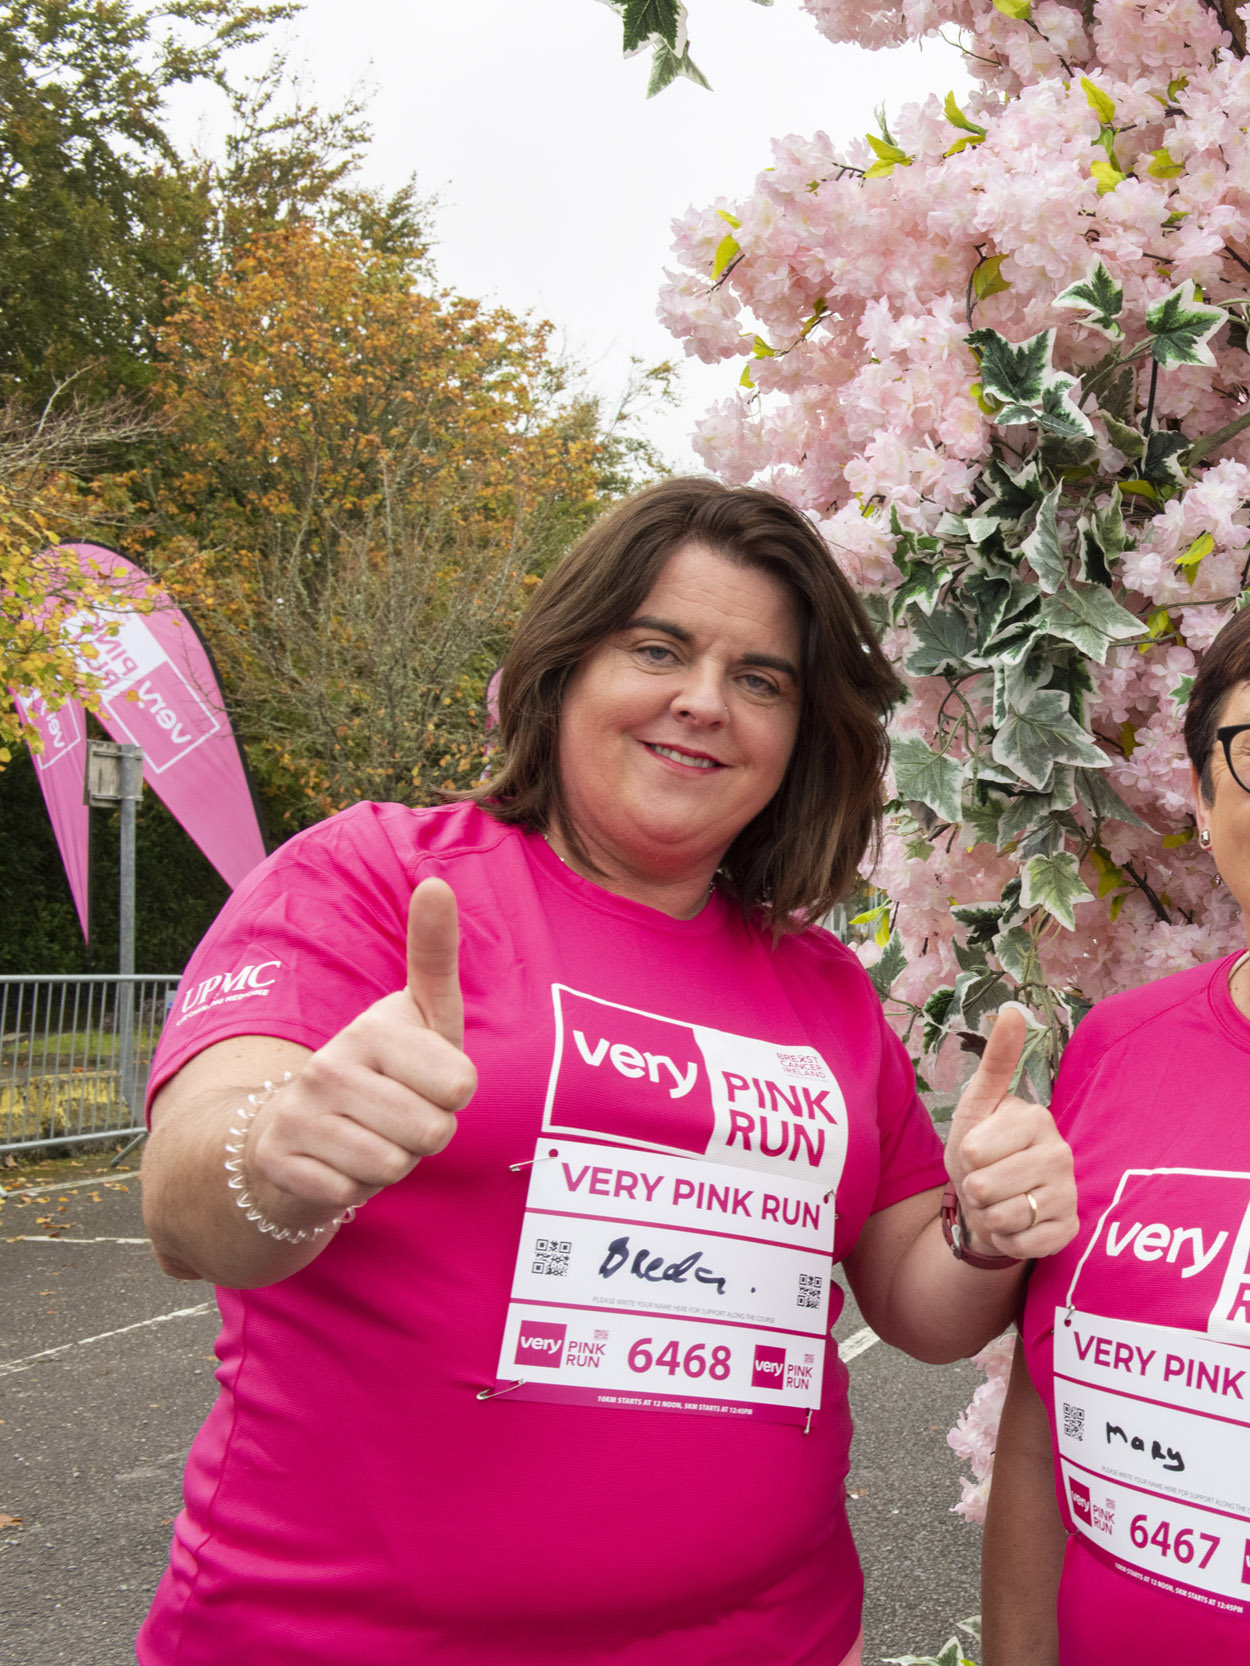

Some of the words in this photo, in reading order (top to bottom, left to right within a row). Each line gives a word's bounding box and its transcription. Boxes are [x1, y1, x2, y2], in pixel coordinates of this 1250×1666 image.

[182, 960, 282, 1013] UPMC
[572, 1029, 698, 1098] very
[783, 1067, 826, 1078] IRELAND
[721, 1071, 838, 1125] PINK
[725, 1108, 825, 1168] RUN
[561, 1162, 665, 1202] VERY
[672, 1178, 754, 1217] PINK
[761, 1193, 821, 1230] RUN
[1105, 1221, 1229, 1279] very
[592, 1296, 615, 1304] PLEASE
[616, 1299, 635, 1307] WRITE
[654, 1303, 672, 1311] NAME
[689, 1306, 700, 1314] FOR
[702, 1307, 726, 1317] SUPPORT
[727, 1311, 745, 1320] ALONG
[746, 1313, 756, 1321] THE
[756, 1315, 776, 1324] COURSE
[520, 1336, 562, 1354] very
[568, 1340, 606, 1355] PINK
[627, 1337, 732, 1380] 6468
[565, 1354, 600, 1368] RUN
[755, 1359, 784, 1377] very
[787, 1364, 813, 1378] PINK
[1073, 1331, 1157, 1376] VERY
[1163, 1354, 1247, 1400] PINK
[786, 1376, 809, 1390] RUN
[617, 1397, 642, 1405] STARTS
[653, 1399, 660, 1407] 12
[698, 1404, 720, 1412] STARTS
[1071, 1490, 1090, 1512] very
[1101, 1465, 1118, 1476] PLEASE
[1118, 1471, 1133, 1481] WRITE
[1134, 1476, 1147, 1486] YOUR
[1148, 1480, 1163, 1490] NAME
[1164, 1484, 1177, 1494] HERE
[1178, 1488, 1189, 1497] FOR
[1189, 1491, 1215, 1504] SUPPORT
[1215, 1498, 1235, 1510] ALONG
[1236, 1503, 1246, 1512] THE
[1093, 1504, 1115, 1525] PINK
[1094, 1516, 1112, 1535] RUN
[1129, 1514, 1221, 1569] 6467
[1126, 1568, 1143, 1580] STARTS
[1188, 1591, 1208, 1604] STARTS
[1208, 1598, 1216, 1606] AT
[1217, 1601, 1244, 1613] 12:45PM
